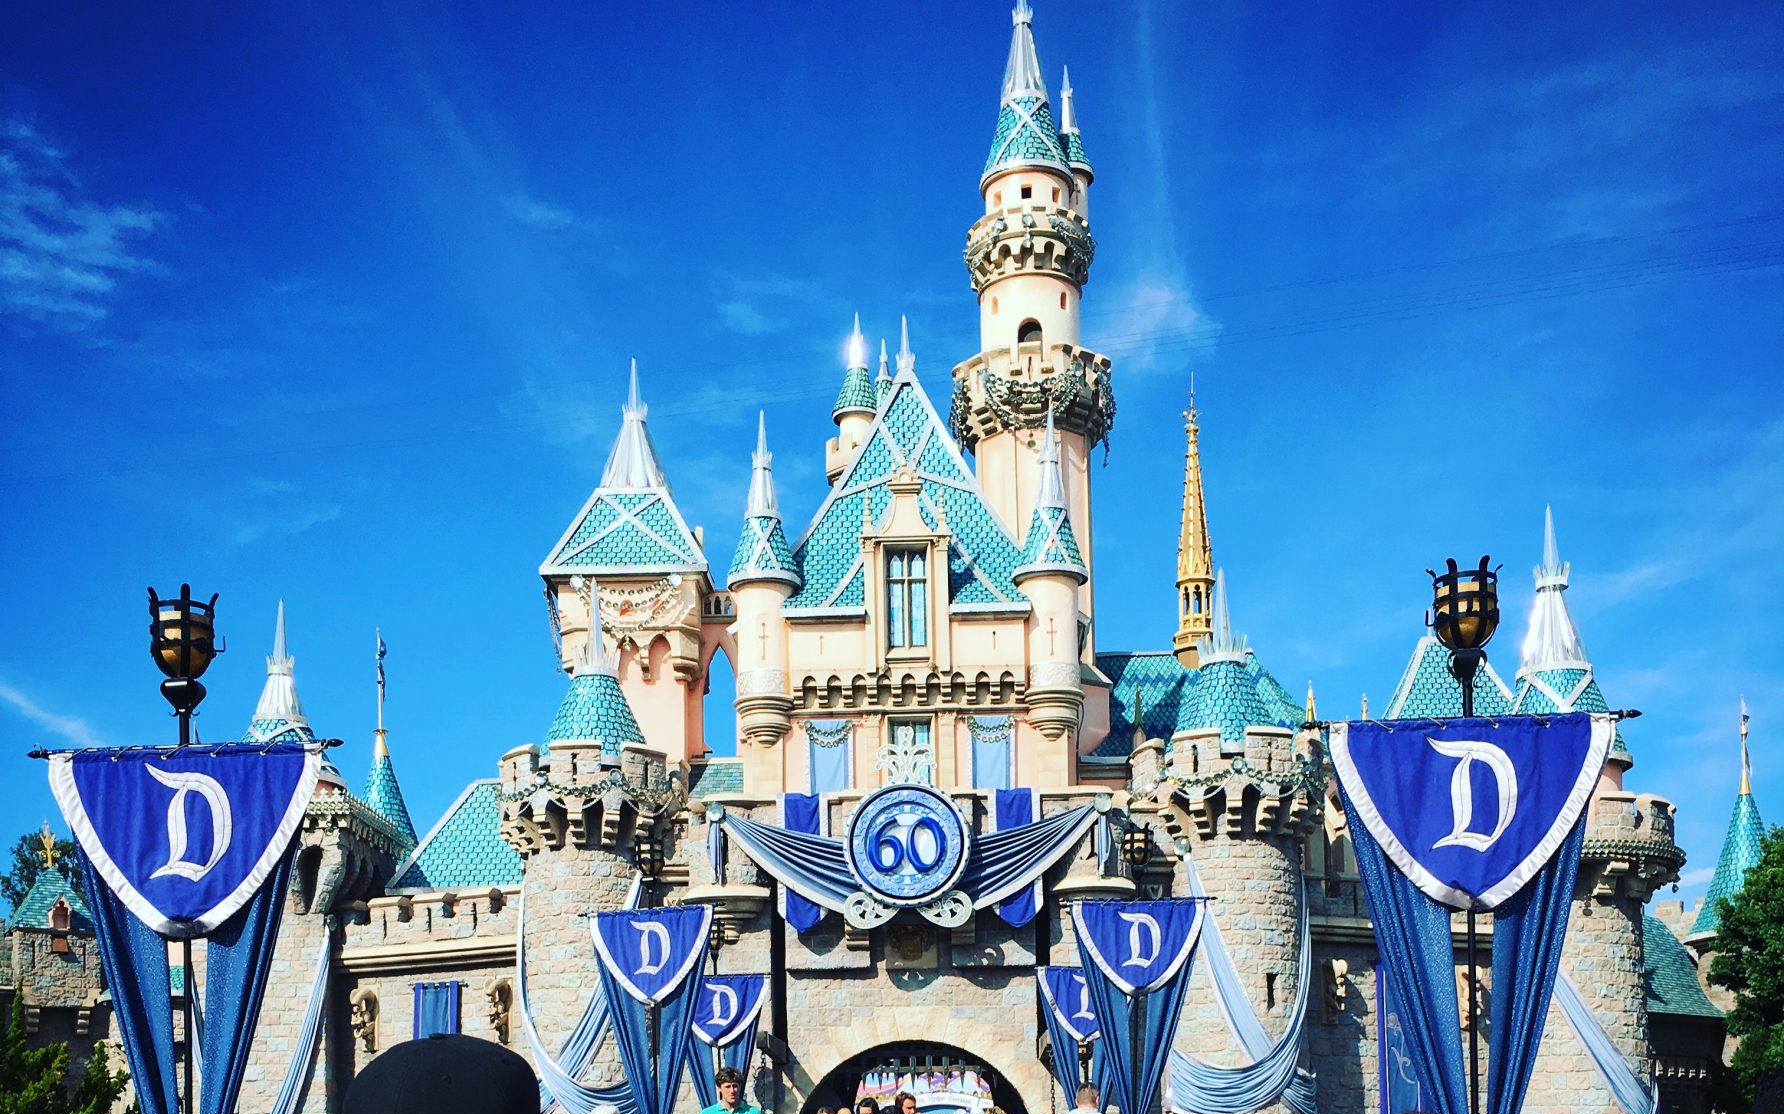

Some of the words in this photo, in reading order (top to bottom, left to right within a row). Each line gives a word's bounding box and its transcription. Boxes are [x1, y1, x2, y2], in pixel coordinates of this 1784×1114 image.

[145, 762, 233, 883] D
[1425, 735, 1518, 853] D
[867, 816, 946, 873] 60
[629, 920, 671, 976] D
[1118, 909, 1162, 968] D
[705, 983, 739, 1027] D
